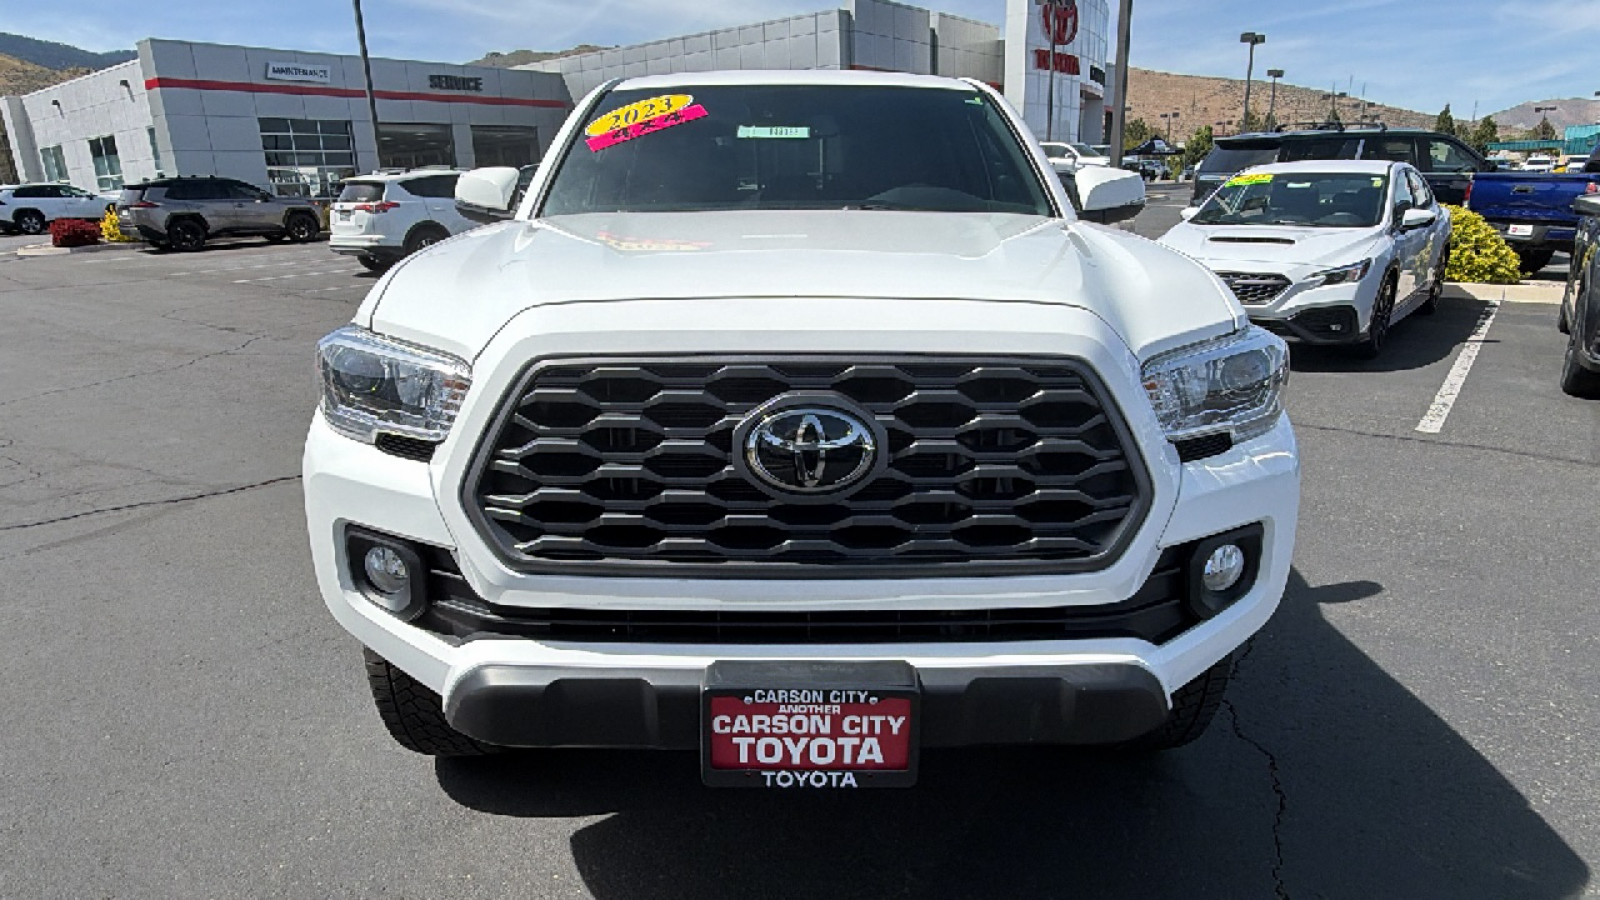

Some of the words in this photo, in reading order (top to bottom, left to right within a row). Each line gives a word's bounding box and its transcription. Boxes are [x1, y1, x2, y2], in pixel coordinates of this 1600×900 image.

[272, 66, 328, 78] MAINTENANCE
[429, 74, 483, 91] SERVICE
[608, 97, 673, 131] 2023
[754, 689, 823, 704] CARSON
[829, 690, 869, 704] CITY
[778, 704, 841, 715] ANOTHER
[712, 714, 831, 735] CARSON
[841, 715, 906, 735] CITY
[731, 737, 884, 765] TOYOTA
[761, 770, 858, 788] TOYOTA
